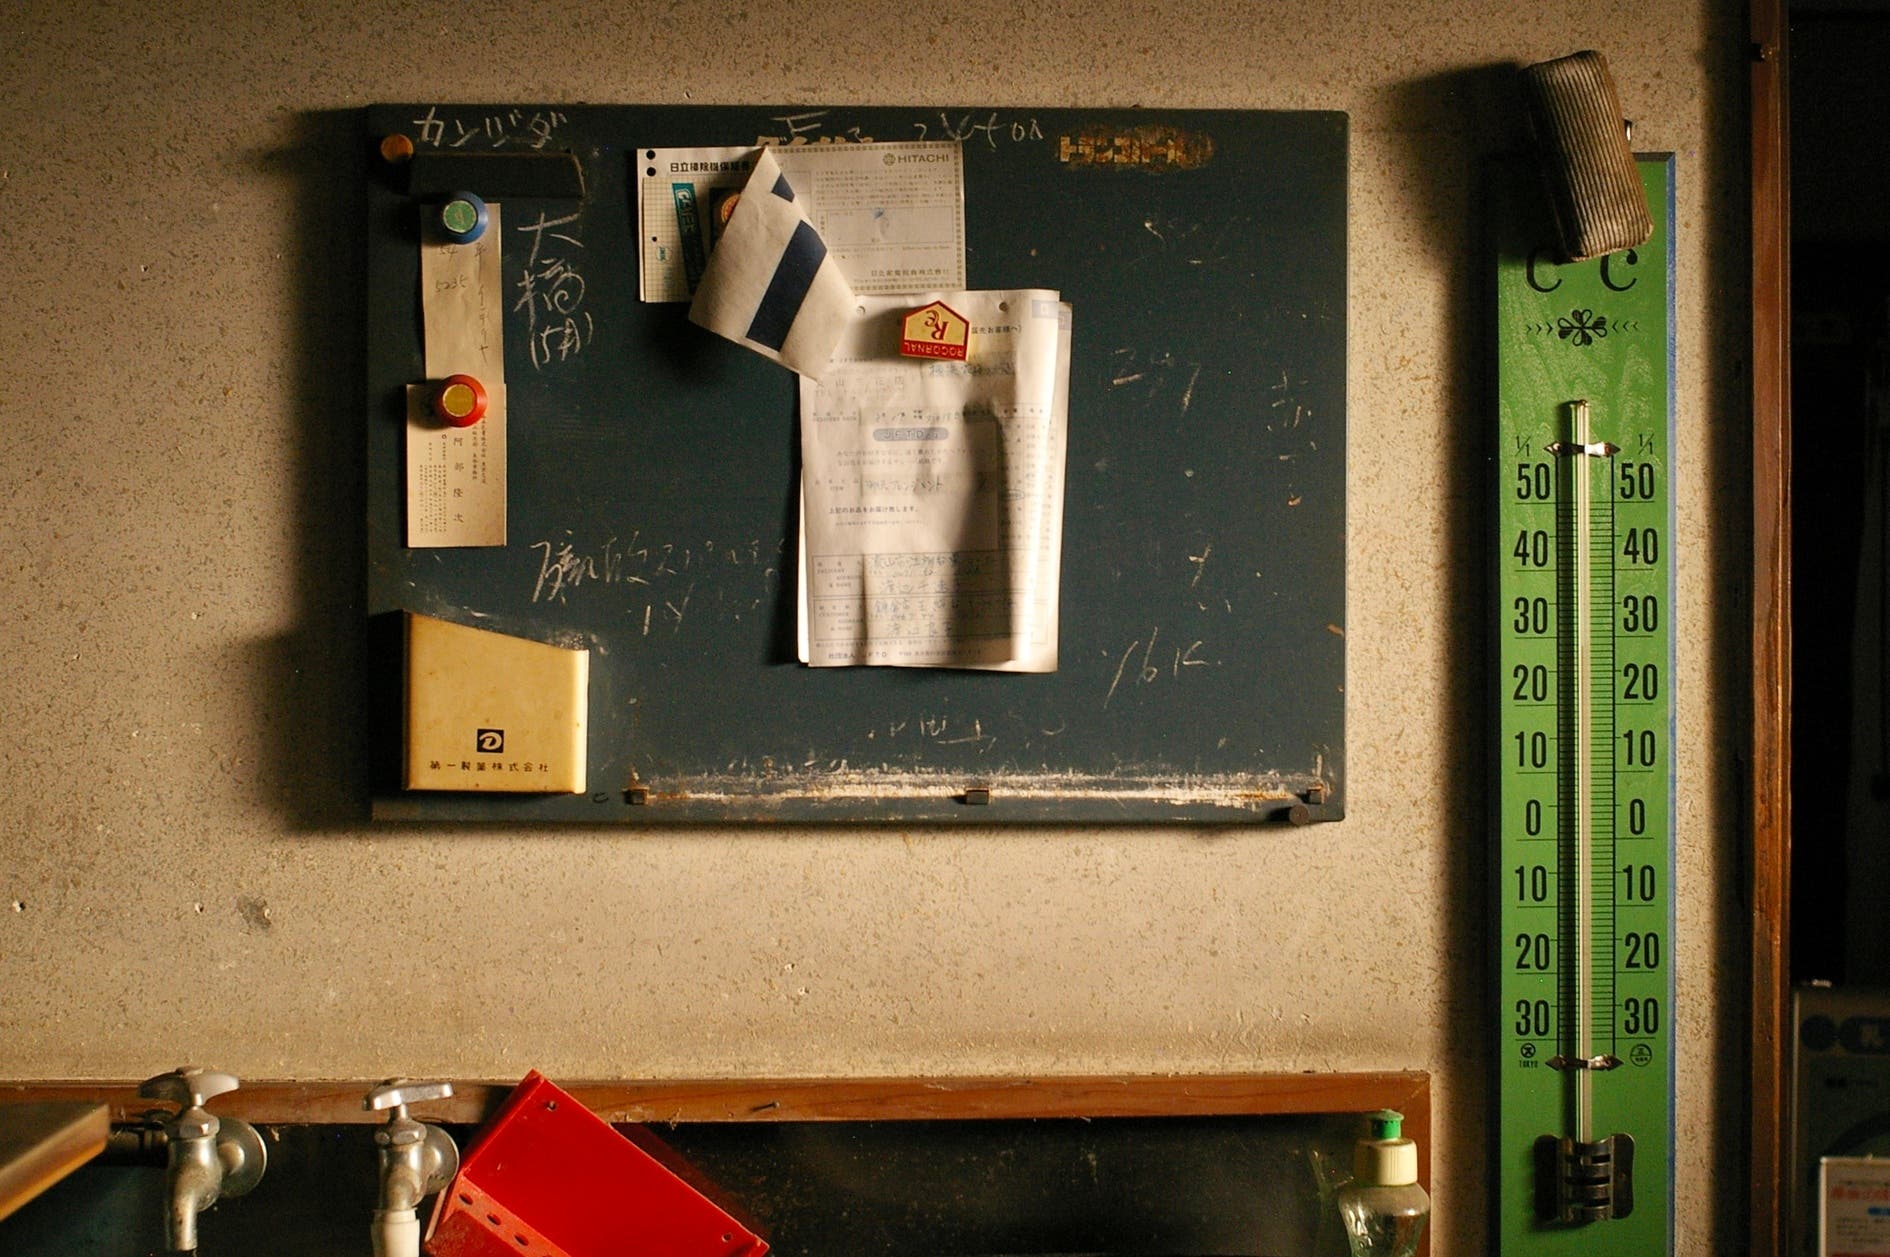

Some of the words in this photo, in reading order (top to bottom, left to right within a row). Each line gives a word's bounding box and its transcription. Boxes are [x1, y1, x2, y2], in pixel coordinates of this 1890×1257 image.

[897, 153, 950, 164] HITACHI
[903, 341, 969, 358] ROCORNAL
[1517, 463, 1551, 500] 50
[1621, 463, 1655, 500] 50
[1514, 529, 1549, 568] 40
[1624, 528, 1659, 565] 40
[1514, 597, 1548, 635] 30
[1624, 595, 1658, 633] 30
[1514, 664, 1548, 702] 20
[1624, 663, 1658, 701] 20
[429, 761, 548, 773] 第一製薬株式会社
[1514, 731, 1547, 768] 10
[1624, 730, 1656, 767] 10
[1525, 800, 1541, 836] 0
[1629, 798, 1646, 835] 0
[1514, 866, 1547, 903] 10
[1623, 865, 1656, 902] 10
[1515, 933, 1550, 970] 20
[1625, 932, 1660, 969] 20
[1515, 1000, 1550, 1037] 30
[1624, 998, 1659, 1035] 30
